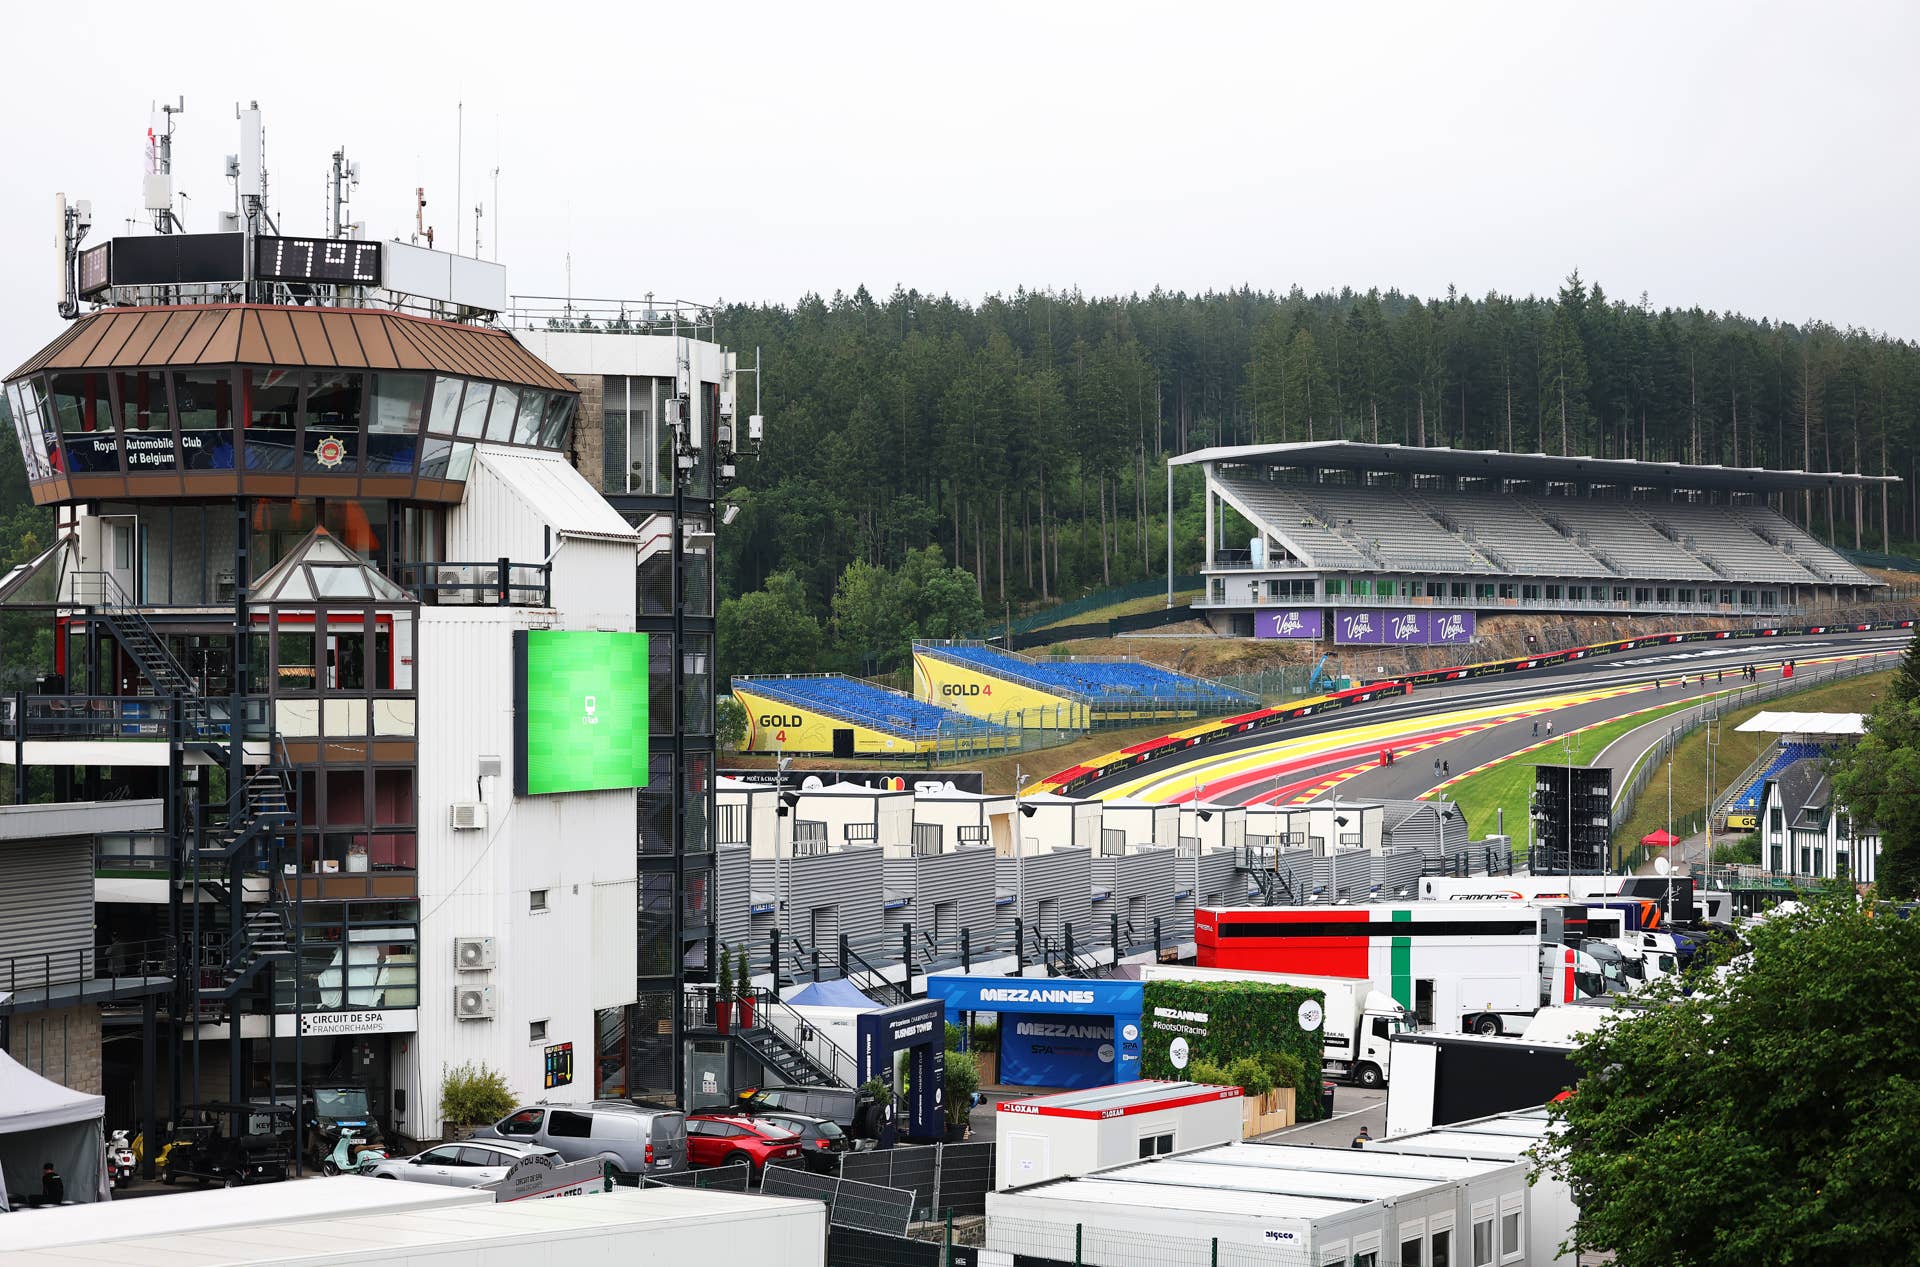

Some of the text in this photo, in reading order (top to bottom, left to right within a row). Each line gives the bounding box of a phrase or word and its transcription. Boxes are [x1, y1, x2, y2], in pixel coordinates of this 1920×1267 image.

[93, 437, 202, 453] Royal Automobile Club
[129, 452, 175, 466] of Belgium
[1272, 612, 1304, 635] Vegas
[1344, 616, 1374, 640] Vegas
[1392, 616, 1420, 640] Vegas
[1438, 616, 1466, 640] Vegas
[942, 684, 992, 696] GOLD 4
[760, 715, 802, 728] GOLD
[776, 730, 787, 742] 4
[980, 988, 1095, 1004] MEZZANINES
[312, 1013, 383, 1024] CIRCUIT DE SPA
[1154, 1007, 1209, 1023] MEZZANINES
[312, 1023, 384, 1033] FRANCORCHAMPS
[894, 1024, 917, 1040] BUSINESS
[915, 1021, 933, 1034] TOWER
[1153, 1021, 1207, 1036] #RootsOfRacing
[1010, 1104, 1039, 1114] LOXAM
[1105, 1108, 1125, 1118] LOXAM
[520, 1157, 534, 1168] YOU
[535, 1156, 553, 1171] SOON
